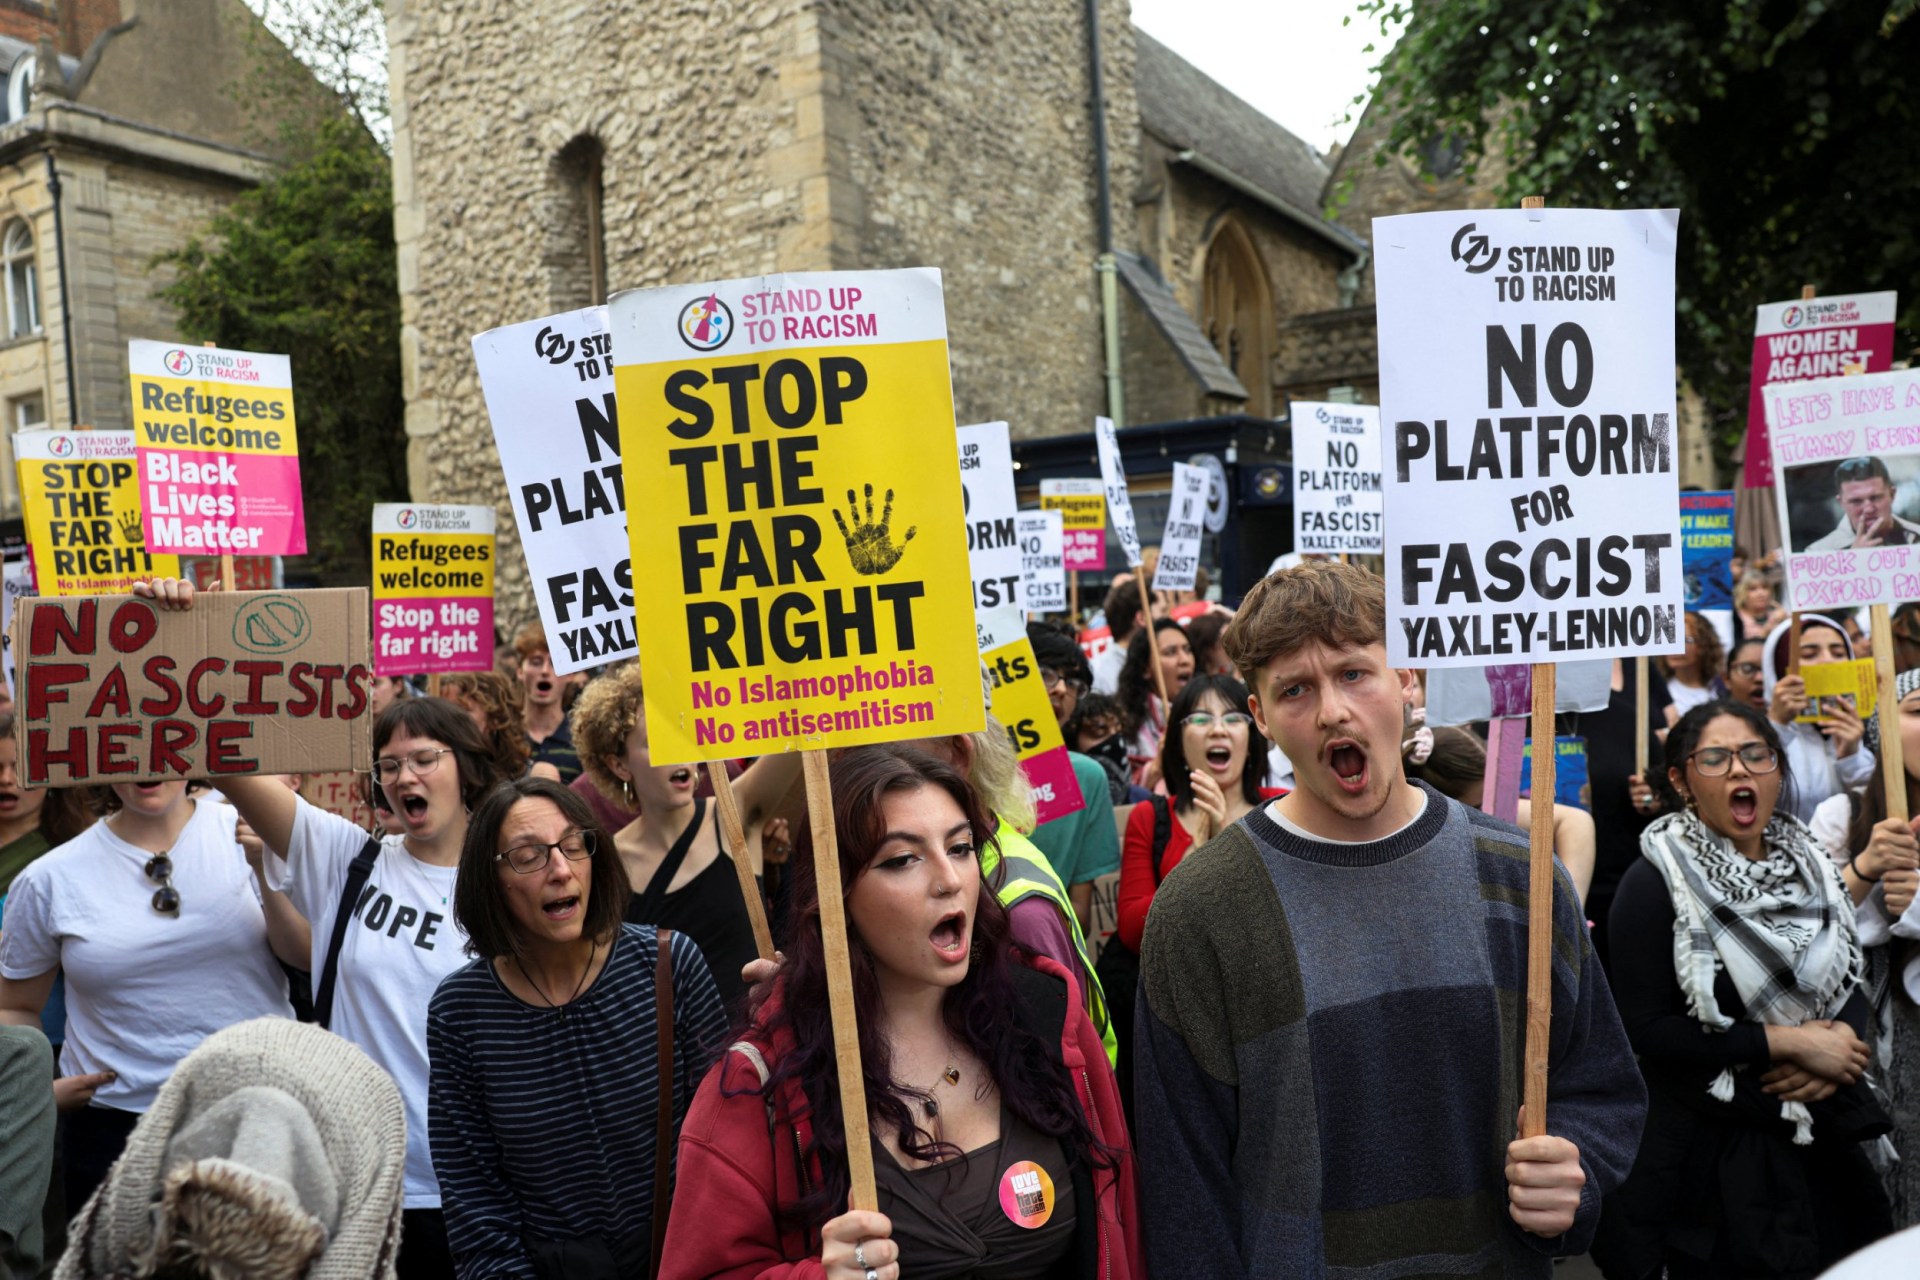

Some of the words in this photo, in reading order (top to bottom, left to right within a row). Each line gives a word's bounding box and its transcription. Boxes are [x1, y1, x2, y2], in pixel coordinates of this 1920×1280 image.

[1508, 246, 1581, 273] STAND
[1588, 246, 1615, 272] UP
[741, 289, 822, 318] STAND
[828, 287, 862, 311] UP
[1495, 275, 1525, 302] TO
[1533, 275, 1616, 301] RACISM
[1807, 303, 1838, 314] STAND
[1840, 301, 1857, 311] UP
[1807, 315, 1818, 325] TO
[1820, 311, 1860, 323] RACISM
[743, 319, 776, 345] TO
[782, 313, 877, 340] RACISM
[1769, 328, 1858, 358] WOMEN
[580, 333, 612, 358] STA
[197, 354, 233, 367] STAND
[237, 358, 252, 369] UP
[199, 366, 213, 377] TO
[216, 368, 260, 381] RACISM
[574, 358, 601, 381] TO
[1486, 321, 1594, 409] NO
[1767, 350, 1873, 380] AGAINST
[141, 382, 285, 423] Refugees
[664, 356, 868, 440] STOP
[1775, 393, 1832, 430] LETS
[1842, 385, 1896, 416] HAVE
[76, 437, 112, 447] STAND
[116, 437, 130, 446] UP
[144, 418, 281, 450] welcome
[576, 392, 621, 463] N
[1864, 425, 1920, 452] ROBIN
[78, 447, 92, 457] TO
[95, 447, 137, 456] RACISM
[963, 444, 978, 457] UP
[1327, 441, 1358, 468] NO
[1395, 413, 1670, 483] PLATFORM
[42, 462, 132, 490] STOP
[146, 452, 239, 486] Black
[669, 435, 825, 516] THE
[1300, 470, 1382, 492] PLATFORM
[45, 491, 113, 518] THE
[149, 484, 235, 517] Lives
[521, 463, 625, 532] PLAT
[1336, 494, 1353, 508] FOR
[1510, 483, 1574, 533] FOR
[420, 510, 450, 519] STAND
[453, 511, 466, 519] UP
[420, 520, 432, 530] TO
[434, 520, 471, 530] RACISM
[1301, 511, 1381, 532] FASCIST
[50, 520, 113, 547] FAR
[151, 517, 263, 549] Matter
[54, 546, 153, 575] RIGHT
[380, 539, 490, 567] Refugees
[678, 514, 825, 595] FAR
[1791, 550, 1857, 579] FUCK
[1868, 547, 1911, 572] OUT
[57, 578, 73, 589] No
[380, 566, 484, 589] welcome
[1400, 533, 1672, 606] FASCIST
[1026, 582, 1061, 597] CIST
[30, 599, 158, 655] NO
[380, 604, 434, 632] Stop
[440, 602, 480, 626] the
[685, 581, 925, 672] RIGHT
[1400, 604, 1676, 658] YAXLEY-LENNON
[380, 632, 414, 657] far
[420, 630, 478, 658] right
[26, 656, 371, 721] FASCISTS
[691, 680, 732, 709] No
[739, 659, 934, 705] Islamophobia
[695, 717, 735, 746] No
[744, 699, 934, 741] antisemitism
[27, 718, 260, 783] HERE
